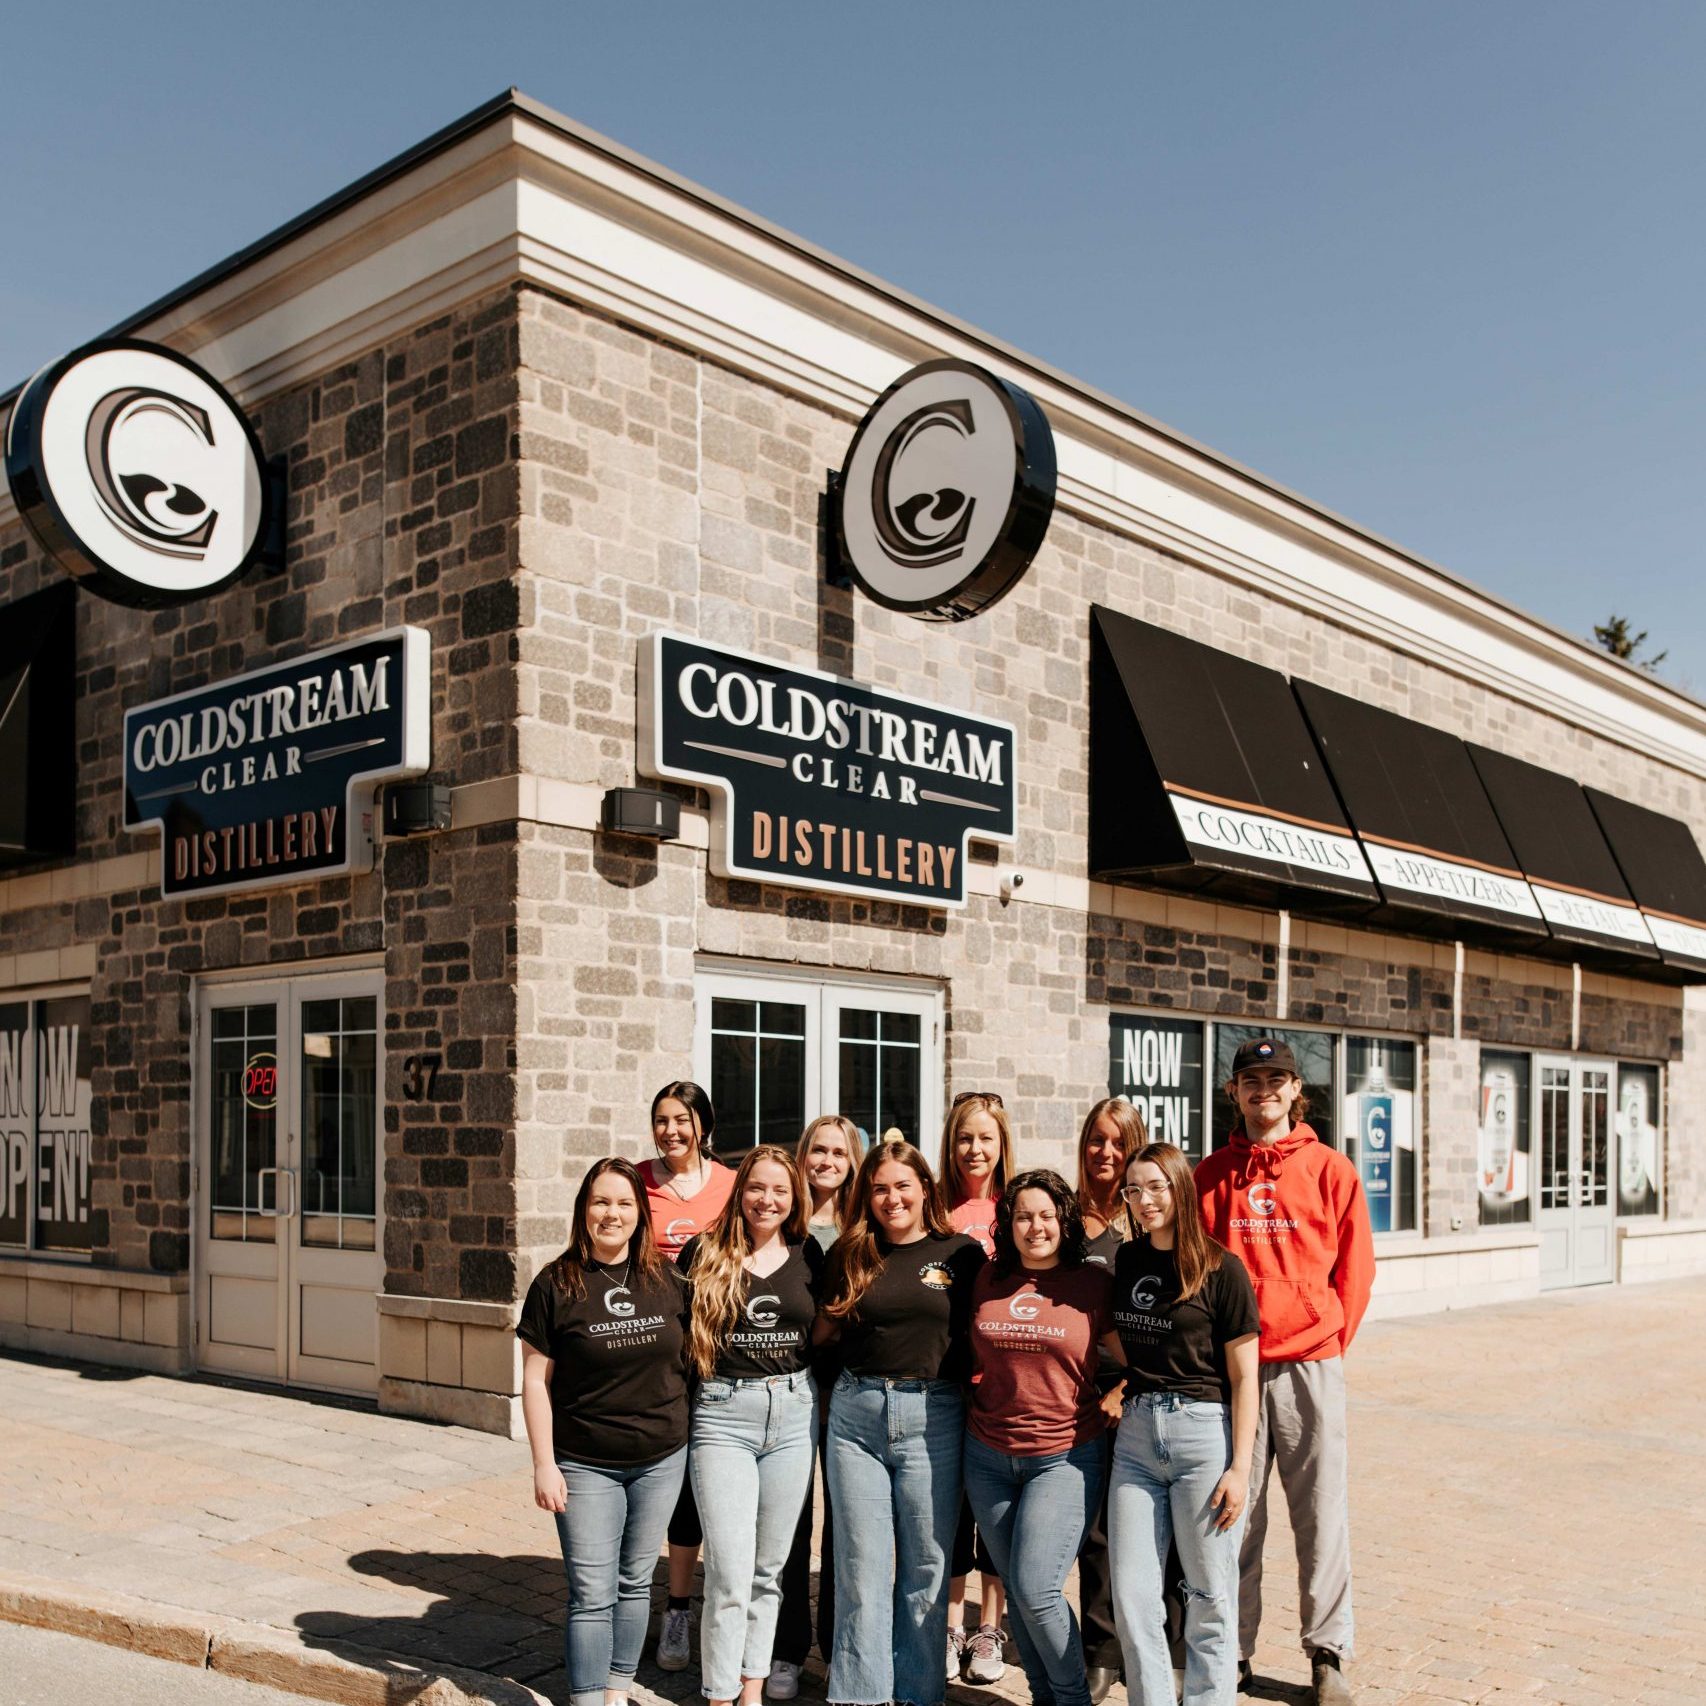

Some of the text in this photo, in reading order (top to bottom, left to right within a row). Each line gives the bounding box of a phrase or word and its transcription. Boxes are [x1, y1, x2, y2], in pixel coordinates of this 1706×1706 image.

[133, 656, 391, 772] COLDSTREAM
[678, 662, 1004, 786] COLDSTREAM
[201, 747, 302, 795] CLEAR
[791, 752, 919, 806] CLEAR
[174, 806, 338, 881] DISTILLERY
[752, 811, 957, 889] DISTILLERY
[1198, 811, 1351, 870] COCKTAILS
[1393, 858, 1519, 908] APPETIZERS
[0, 1024, 79, 1117] NOW
[403, 1054, 442, 1101] 37
[1123, 1028, 1183, 1087] NOW
[1117, 1094, 1190, 1151] PEN!
[1229, 1218, 1299, 1229] COLDSTREAM
[1243, 1236, 1287, 1245] DISTILLERY
[589, 1315, 665, 1333] COLDSTREAM
[606, 1333, 658, 1350] DISTILLERY
[614, 1326, 646, 1336] CLEAR
[725, 1331, 800, 1343] COLDSTREAM
[979, 1321, 1067, 1338] COLDSTREAM
[1002, 1331, 1038, 1340] CLEAR
[746, 1349, 789, 1359] ISTILERY
